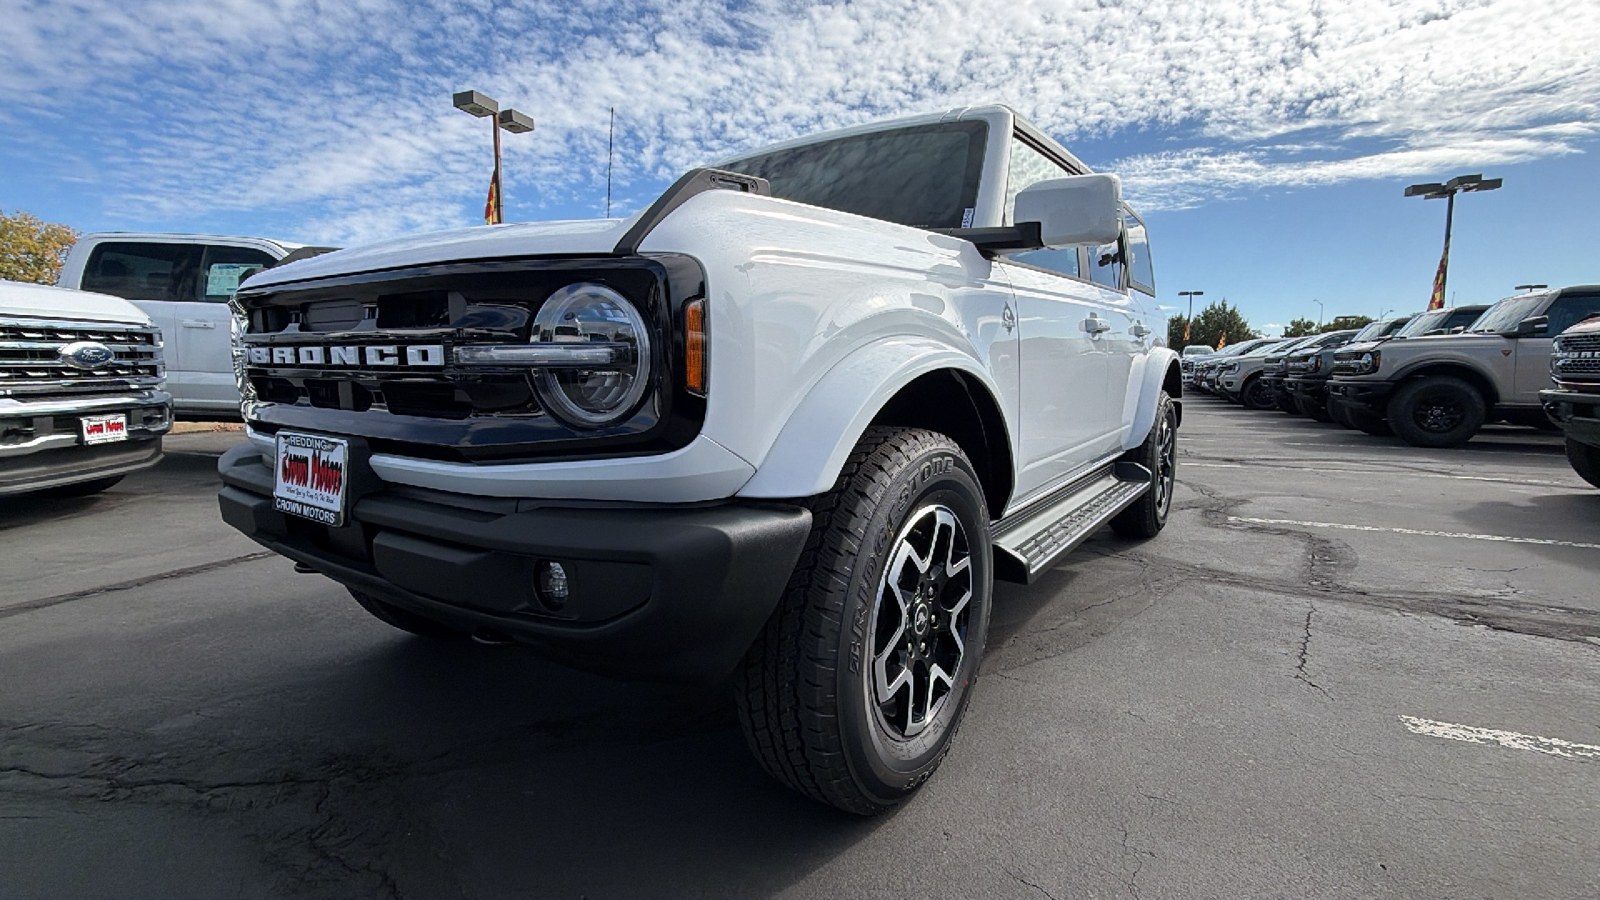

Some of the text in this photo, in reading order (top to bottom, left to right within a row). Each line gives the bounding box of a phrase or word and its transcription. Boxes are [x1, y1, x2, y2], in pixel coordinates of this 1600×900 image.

[250, 344, 445, 366] BRONCO
[290, 436, 327, 450] REDDING
[282, 449, 342, 496] Crown Motors
[276, 498, 336, 524] CROWN MOTORS
[849, 456, 954, 675] BRIDGESTONE
